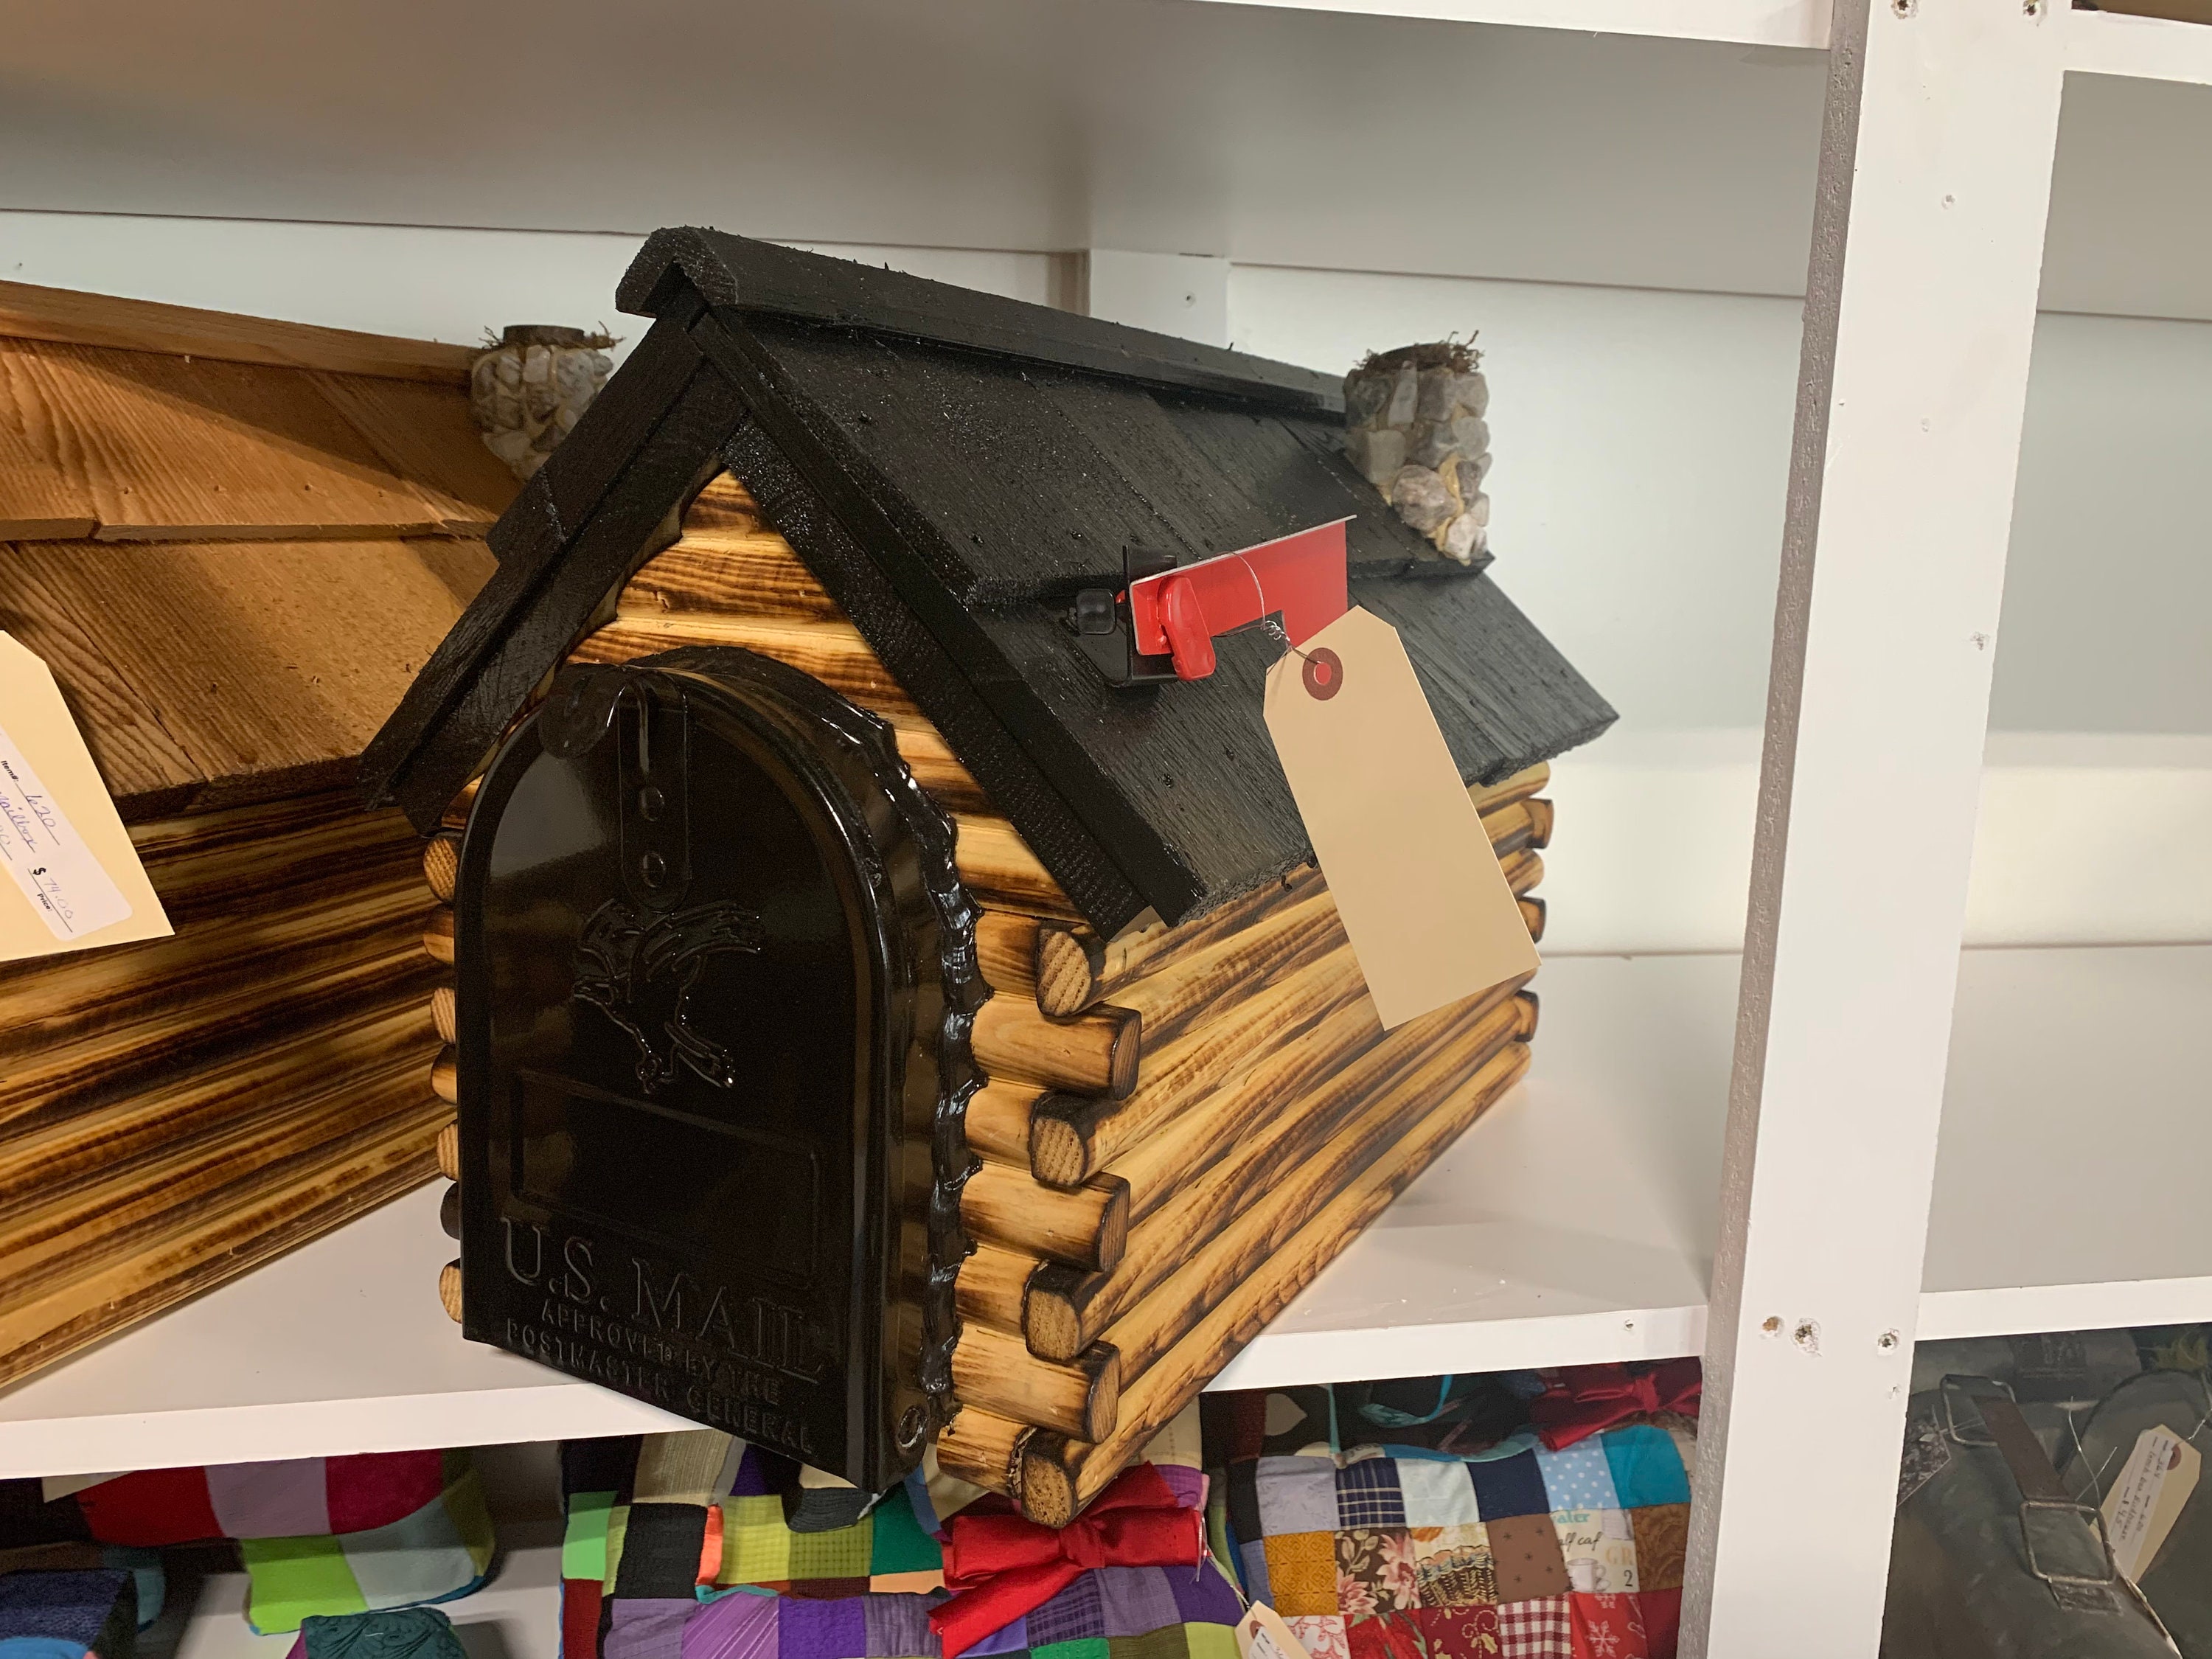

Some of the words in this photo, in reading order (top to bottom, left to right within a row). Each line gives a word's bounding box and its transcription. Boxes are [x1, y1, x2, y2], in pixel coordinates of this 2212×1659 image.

[32, 867, 46, 876] $
[499, 1217, 609, 1312] U.S.
[631, 1256, 823, 1385] MAIL
[542, 1298, 672, 1364] APPROVED
[685, 1349, 716, 1381] BY
[726, 1363, 781, 1407] THE
[507, 1317, 669, 1403] POSTMASTER
[686, 1384, 813, 1455] GENERAL
[1577, 1531, 1604, 1551] caf
[1624, 1569, 1633, 1587] 2
